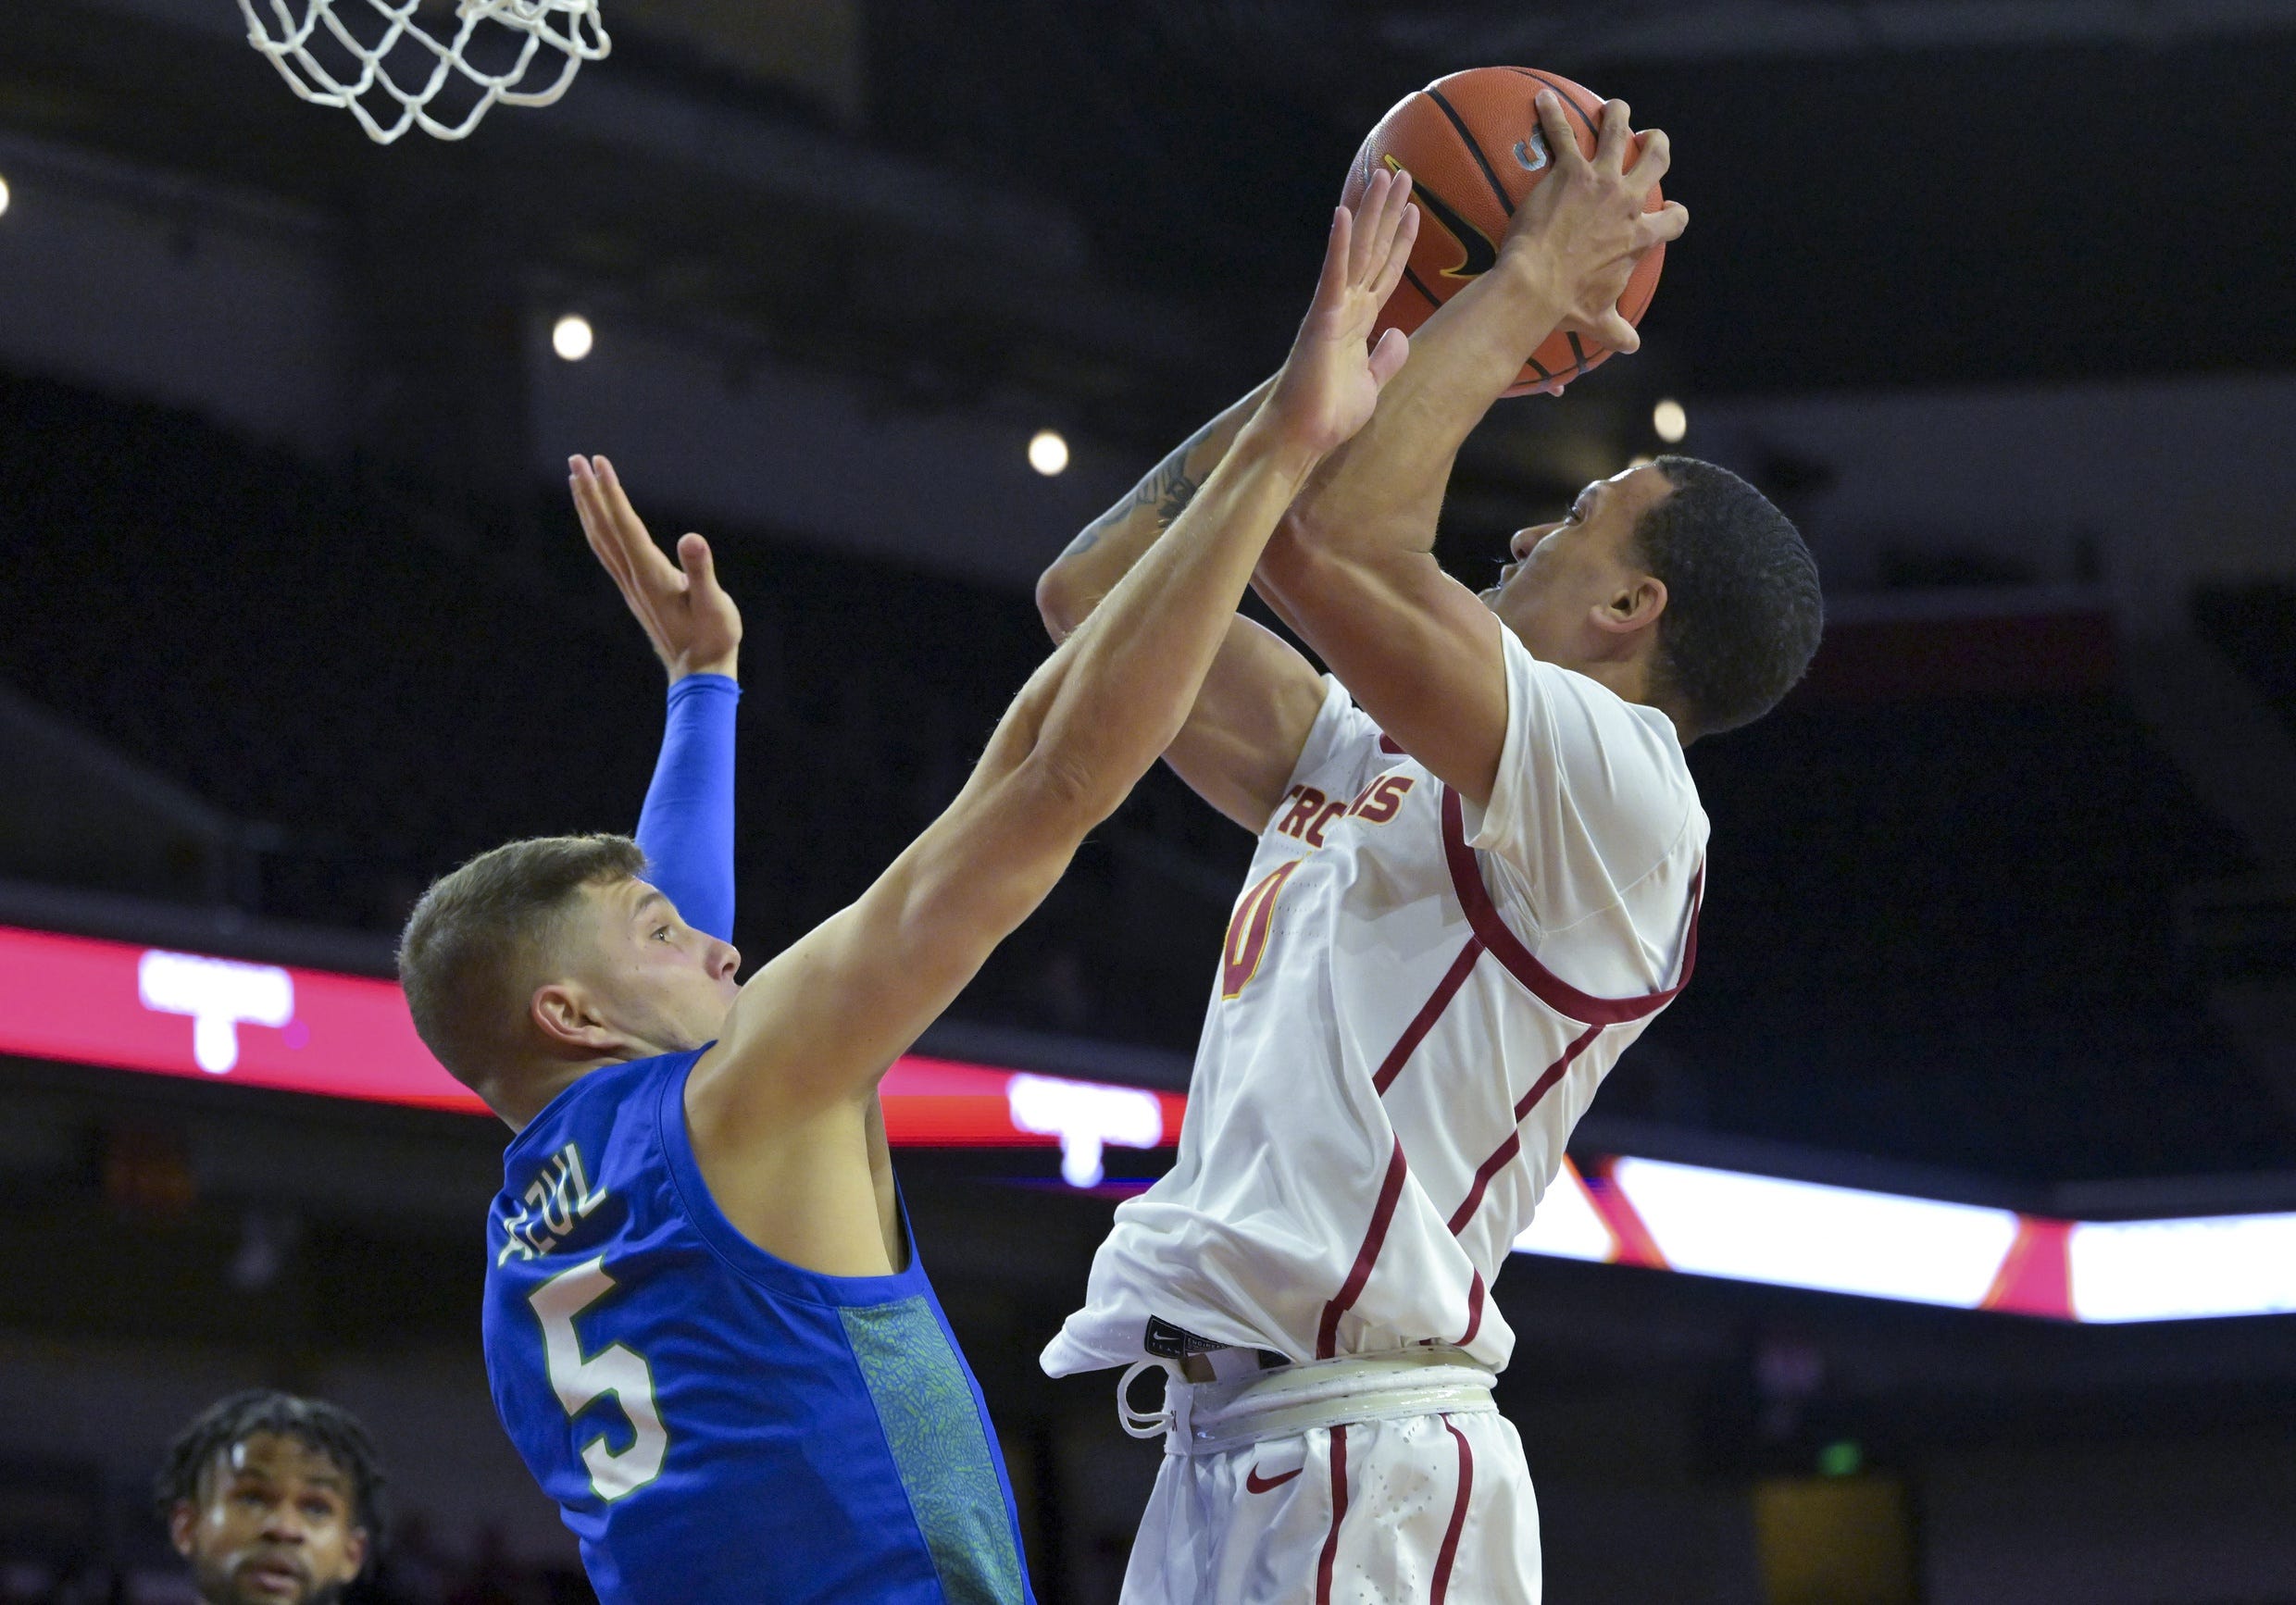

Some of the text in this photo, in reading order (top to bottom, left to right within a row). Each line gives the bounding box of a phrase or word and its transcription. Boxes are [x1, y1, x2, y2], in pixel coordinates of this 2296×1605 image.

[1222, 859, 1302, 1001] 0
[138, 948, 294, 1075] T
[1004, 1072, 1163, 1188] T
[497, 1142, 607, 1267] AZUL
[529, 1255, 668, 1502] 5
[1152, 1341, 1181, 1354] TEAM
